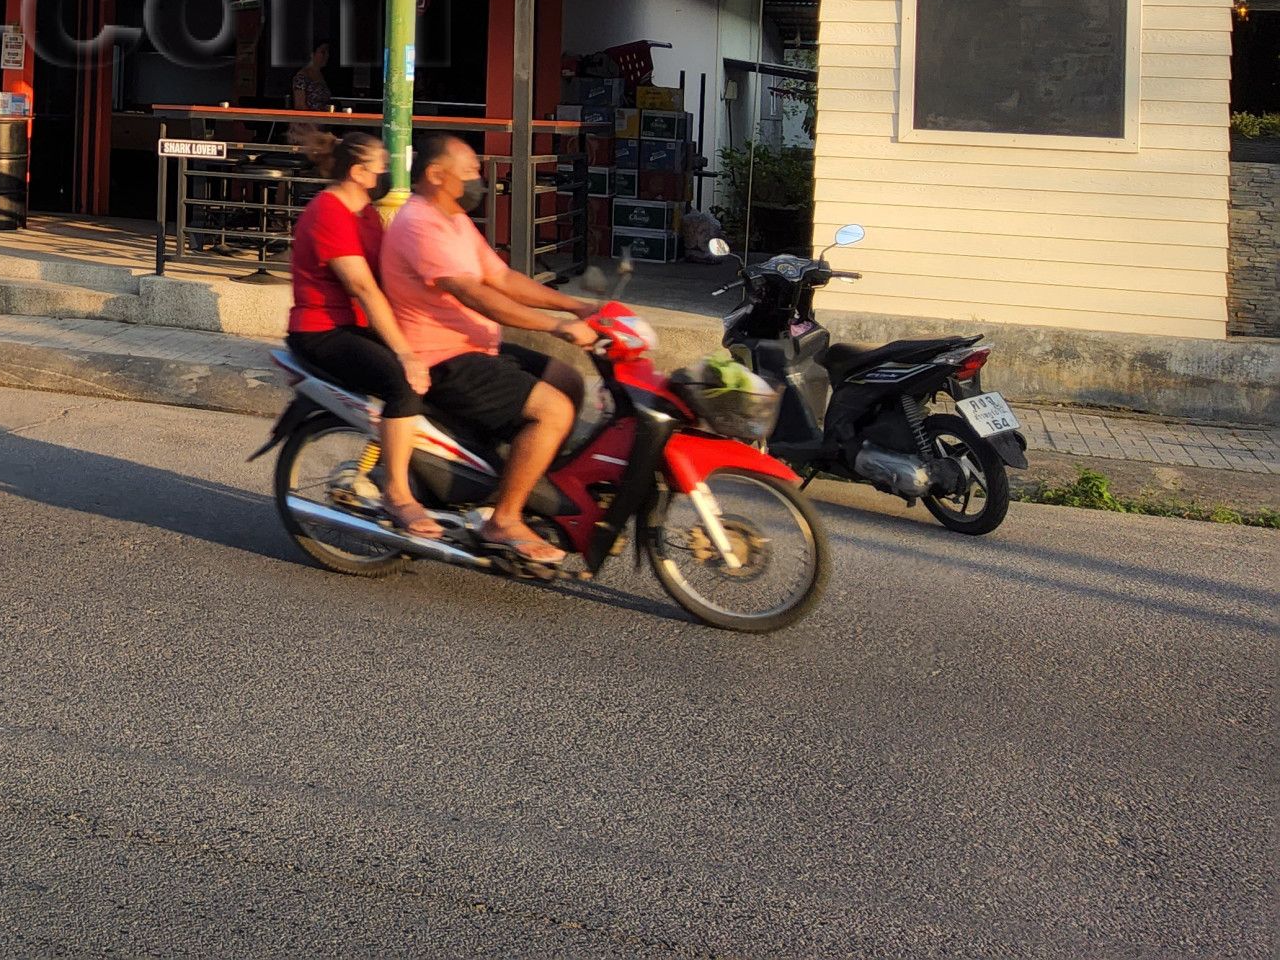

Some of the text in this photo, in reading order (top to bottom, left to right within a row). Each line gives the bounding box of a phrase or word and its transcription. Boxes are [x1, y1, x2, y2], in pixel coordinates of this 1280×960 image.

[163, 142, 191, 154] SHARK
[192, 143, 218, 156] LOVER
[986, 417, 1011, 432] 164
